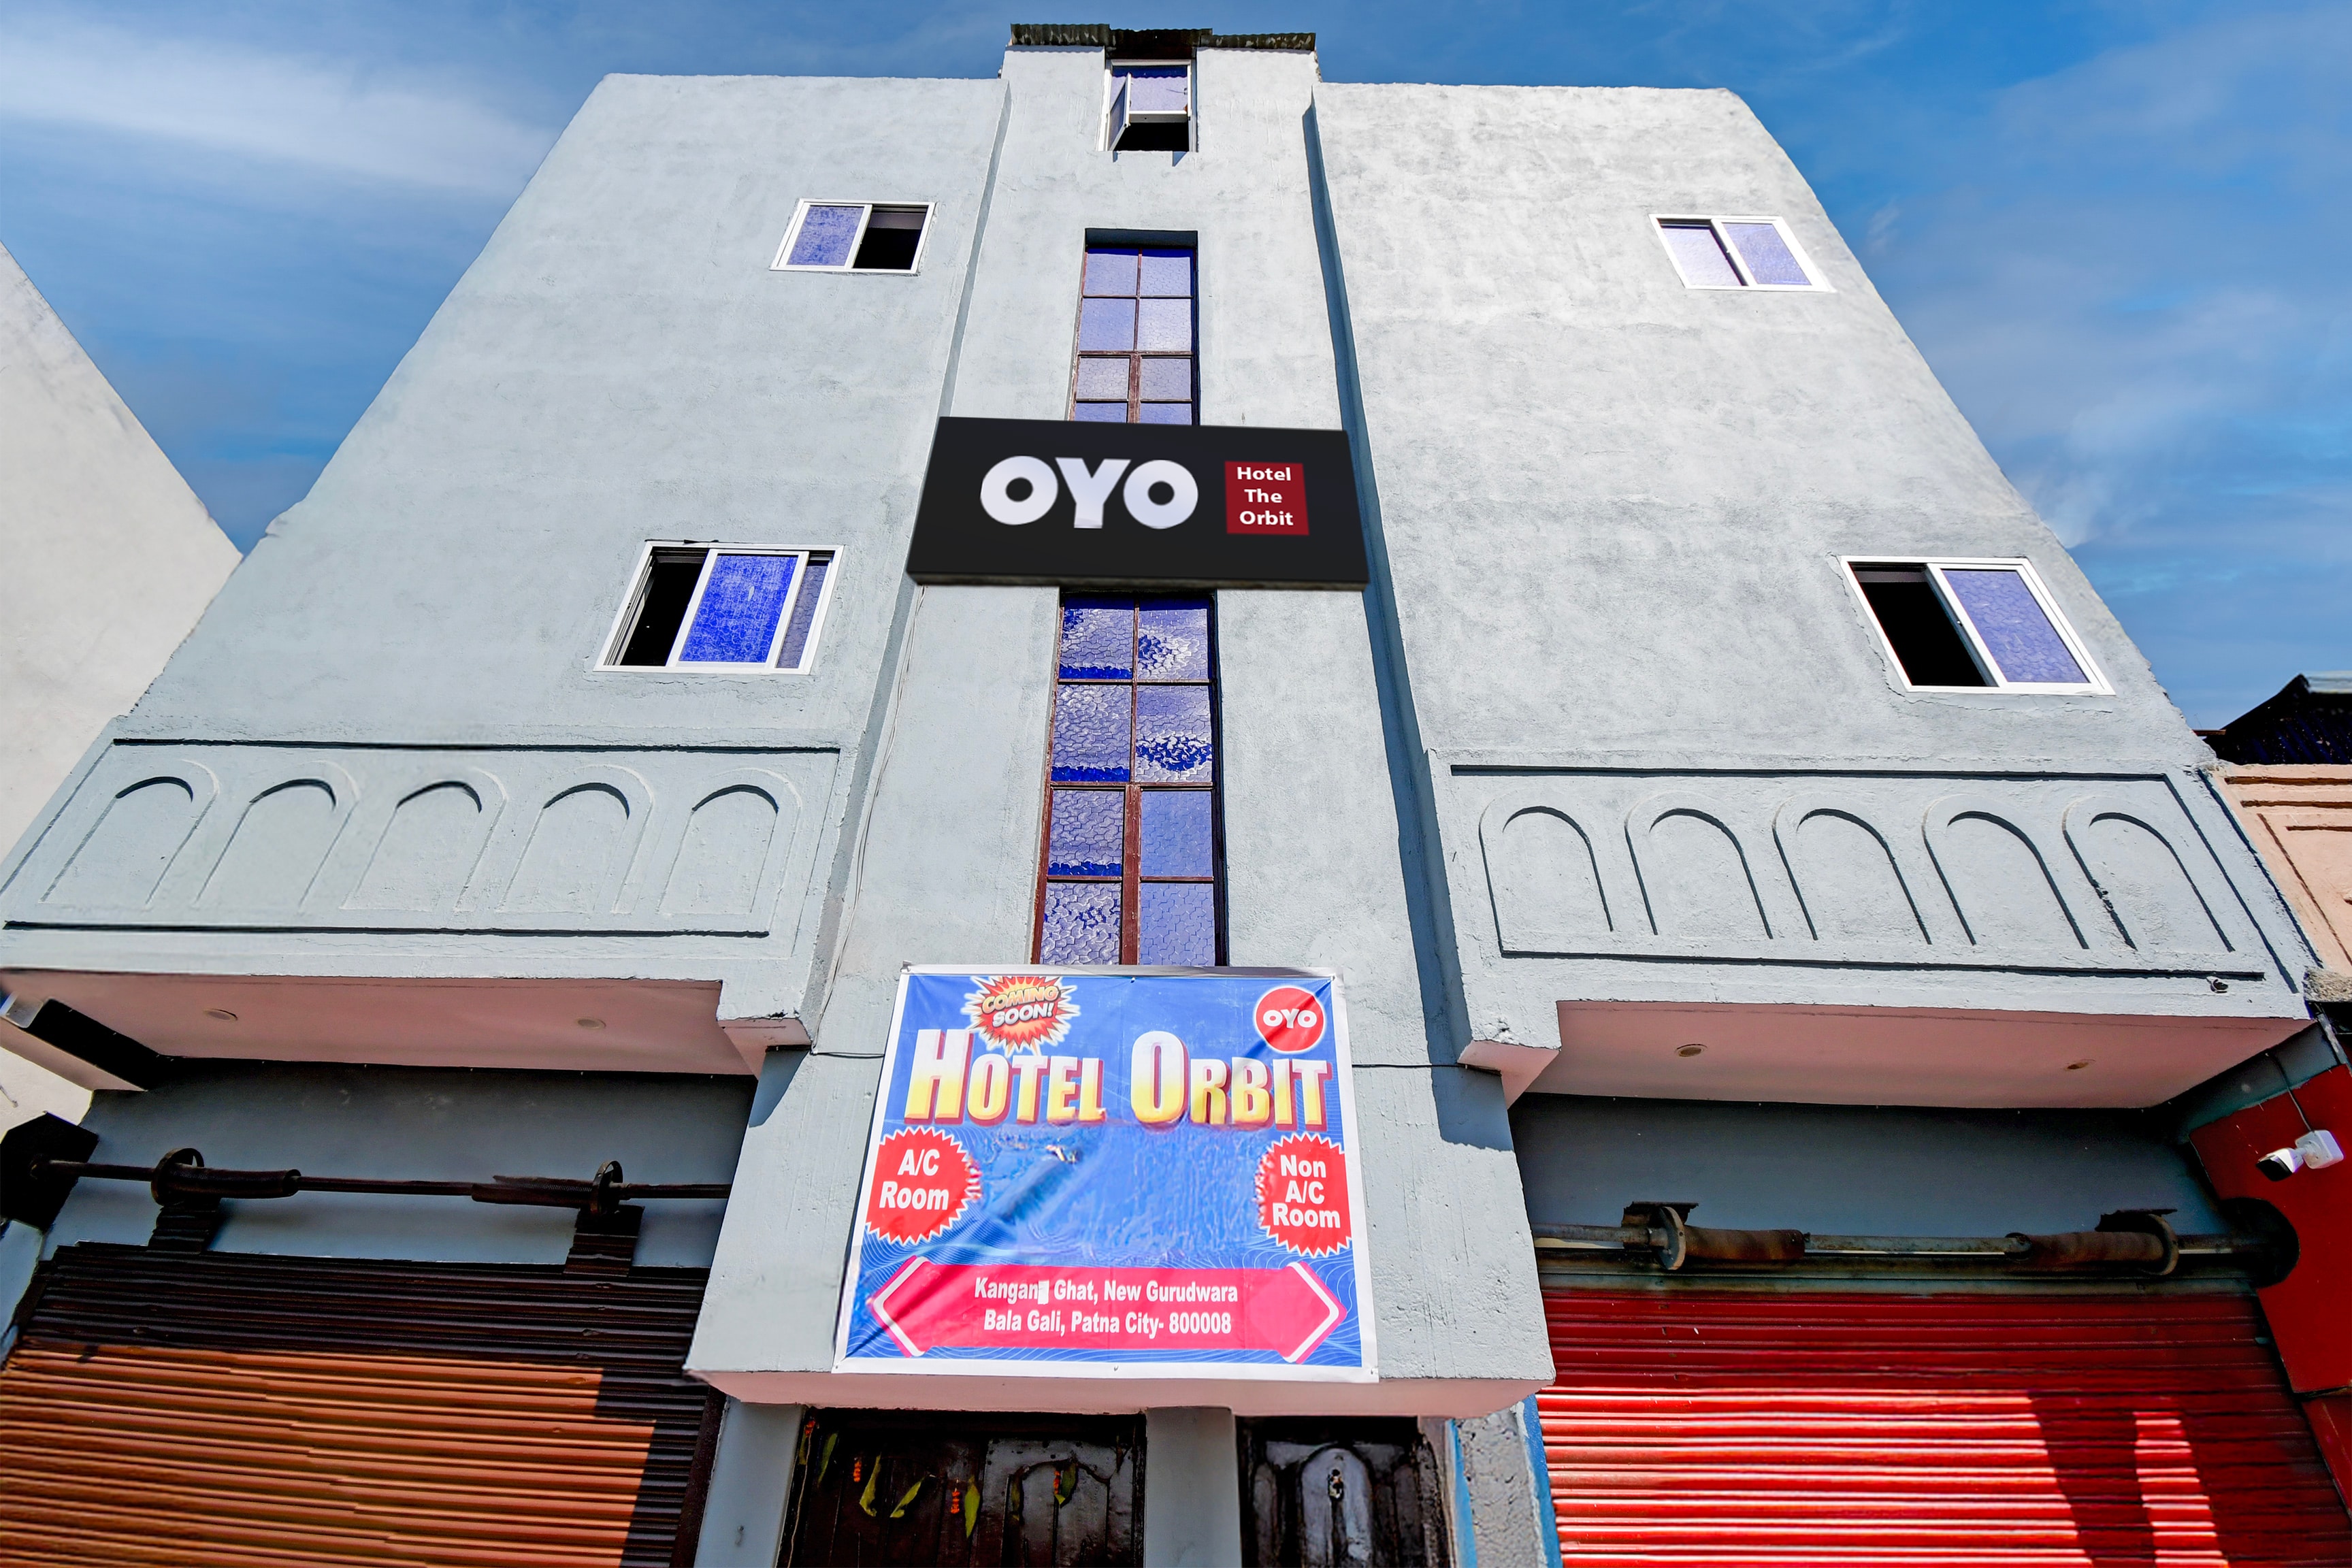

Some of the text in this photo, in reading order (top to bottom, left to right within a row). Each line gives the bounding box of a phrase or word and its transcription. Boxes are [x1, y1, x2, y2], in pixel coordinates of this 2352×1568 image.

[1237, 467, 1291, 480] Hotel
[980, 455, 1198, 529] OYO
[1244, 488, 1282, 502] The
[1239, 510, 1294, 525] Orbit
[982, 986, 1060, 1013] COMING
[992, 1002, 1054, 1028] SOON!
[1262, 1009, 1317, 1028] OYO
[897, 1149, 940, 1176] A/C
[1280, 1155, 1326, 1178] Non
[879, 1181, 949, 1210] Room
[1285, 1180, 1325, 1204] A/C
[1273, 1203, 1341, 1228] Room
[1054, 1279, 1098, 1305] Ghat,
[1104, 1280, 1141, 1301] New
[1146, 1280, 1238, 1302] Gurudwara
[984, 1309, 1231, 1339] Bala Gali, Patna City- 800008
